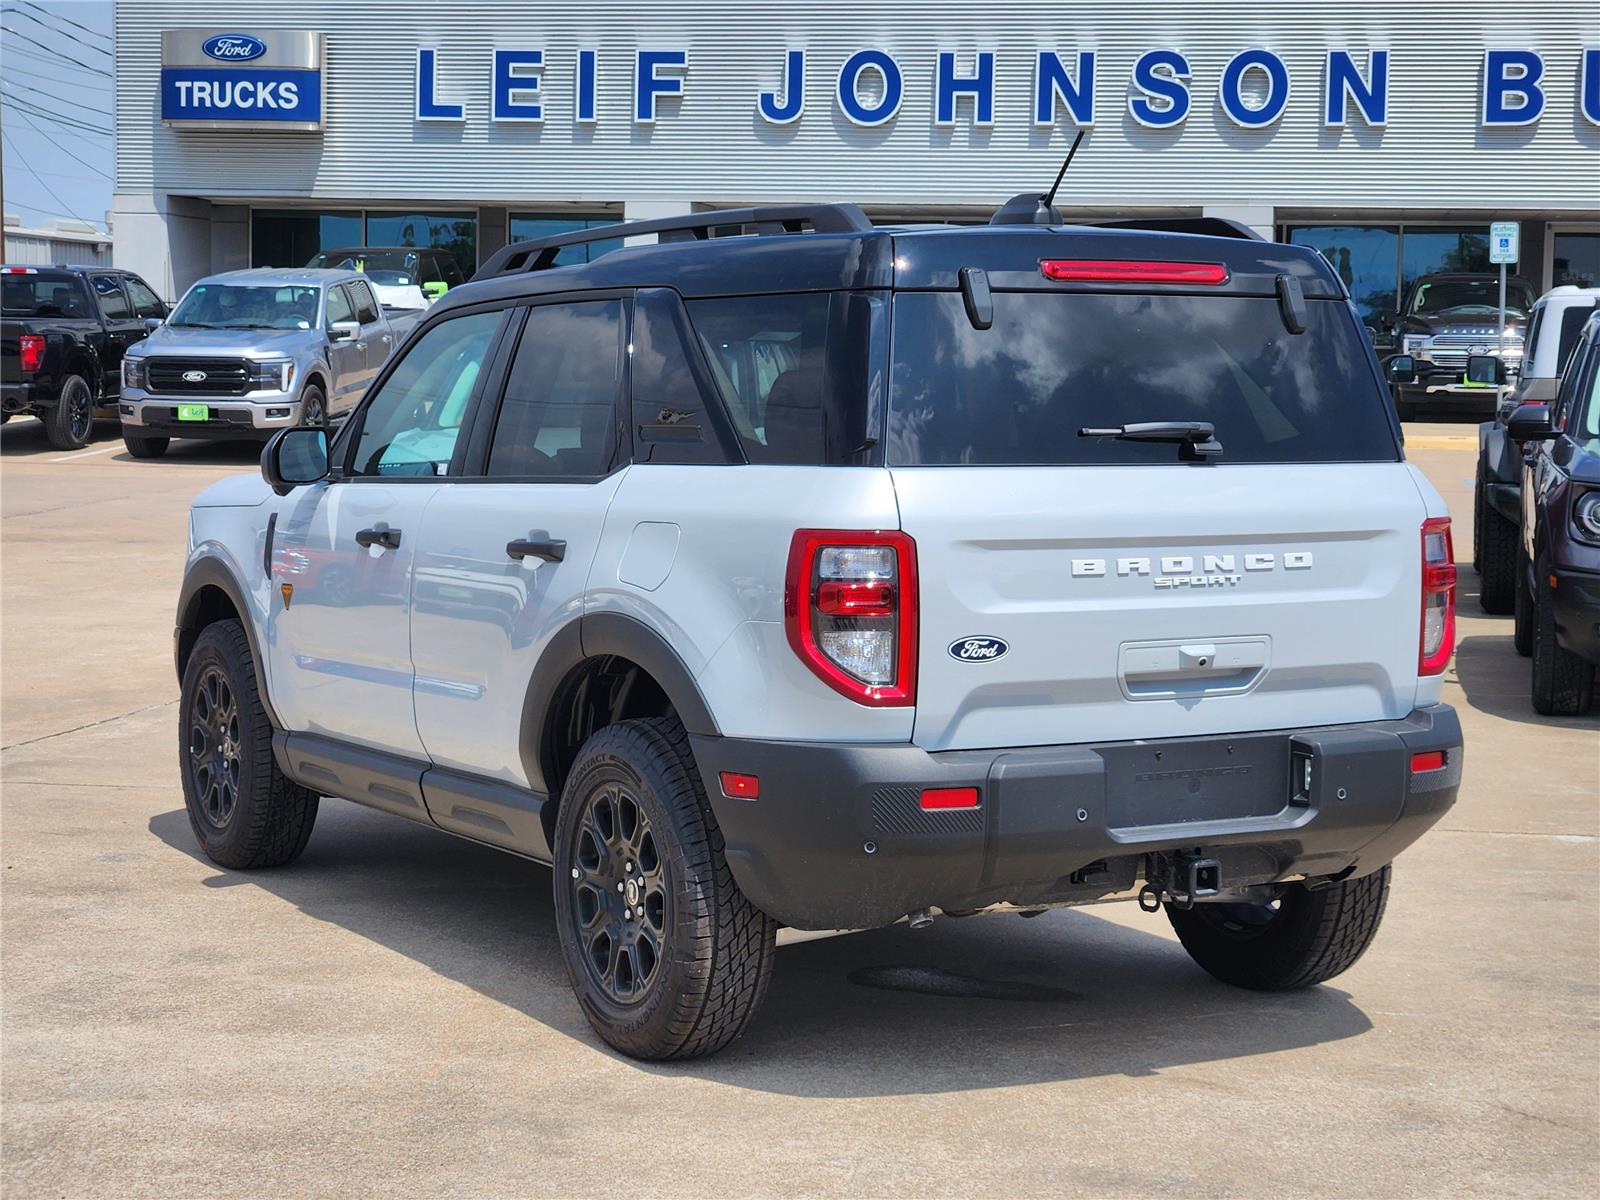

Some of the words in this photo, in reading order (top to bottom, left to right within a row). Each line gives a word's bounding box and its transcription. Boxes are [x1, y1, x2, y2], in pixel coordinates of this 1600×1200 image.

[213, 38, 254, 56] Ford
[175, 80, 299, 110] TRUCKS
[416, 48, 689, 123] LEIF
[757, 47, 1390, 129] JOHNSON
[1071, 552, 1313, 577] BRONCO
[1154, 575, 1242, 589] SPORT
[960, 640, 999, 657] Ford
